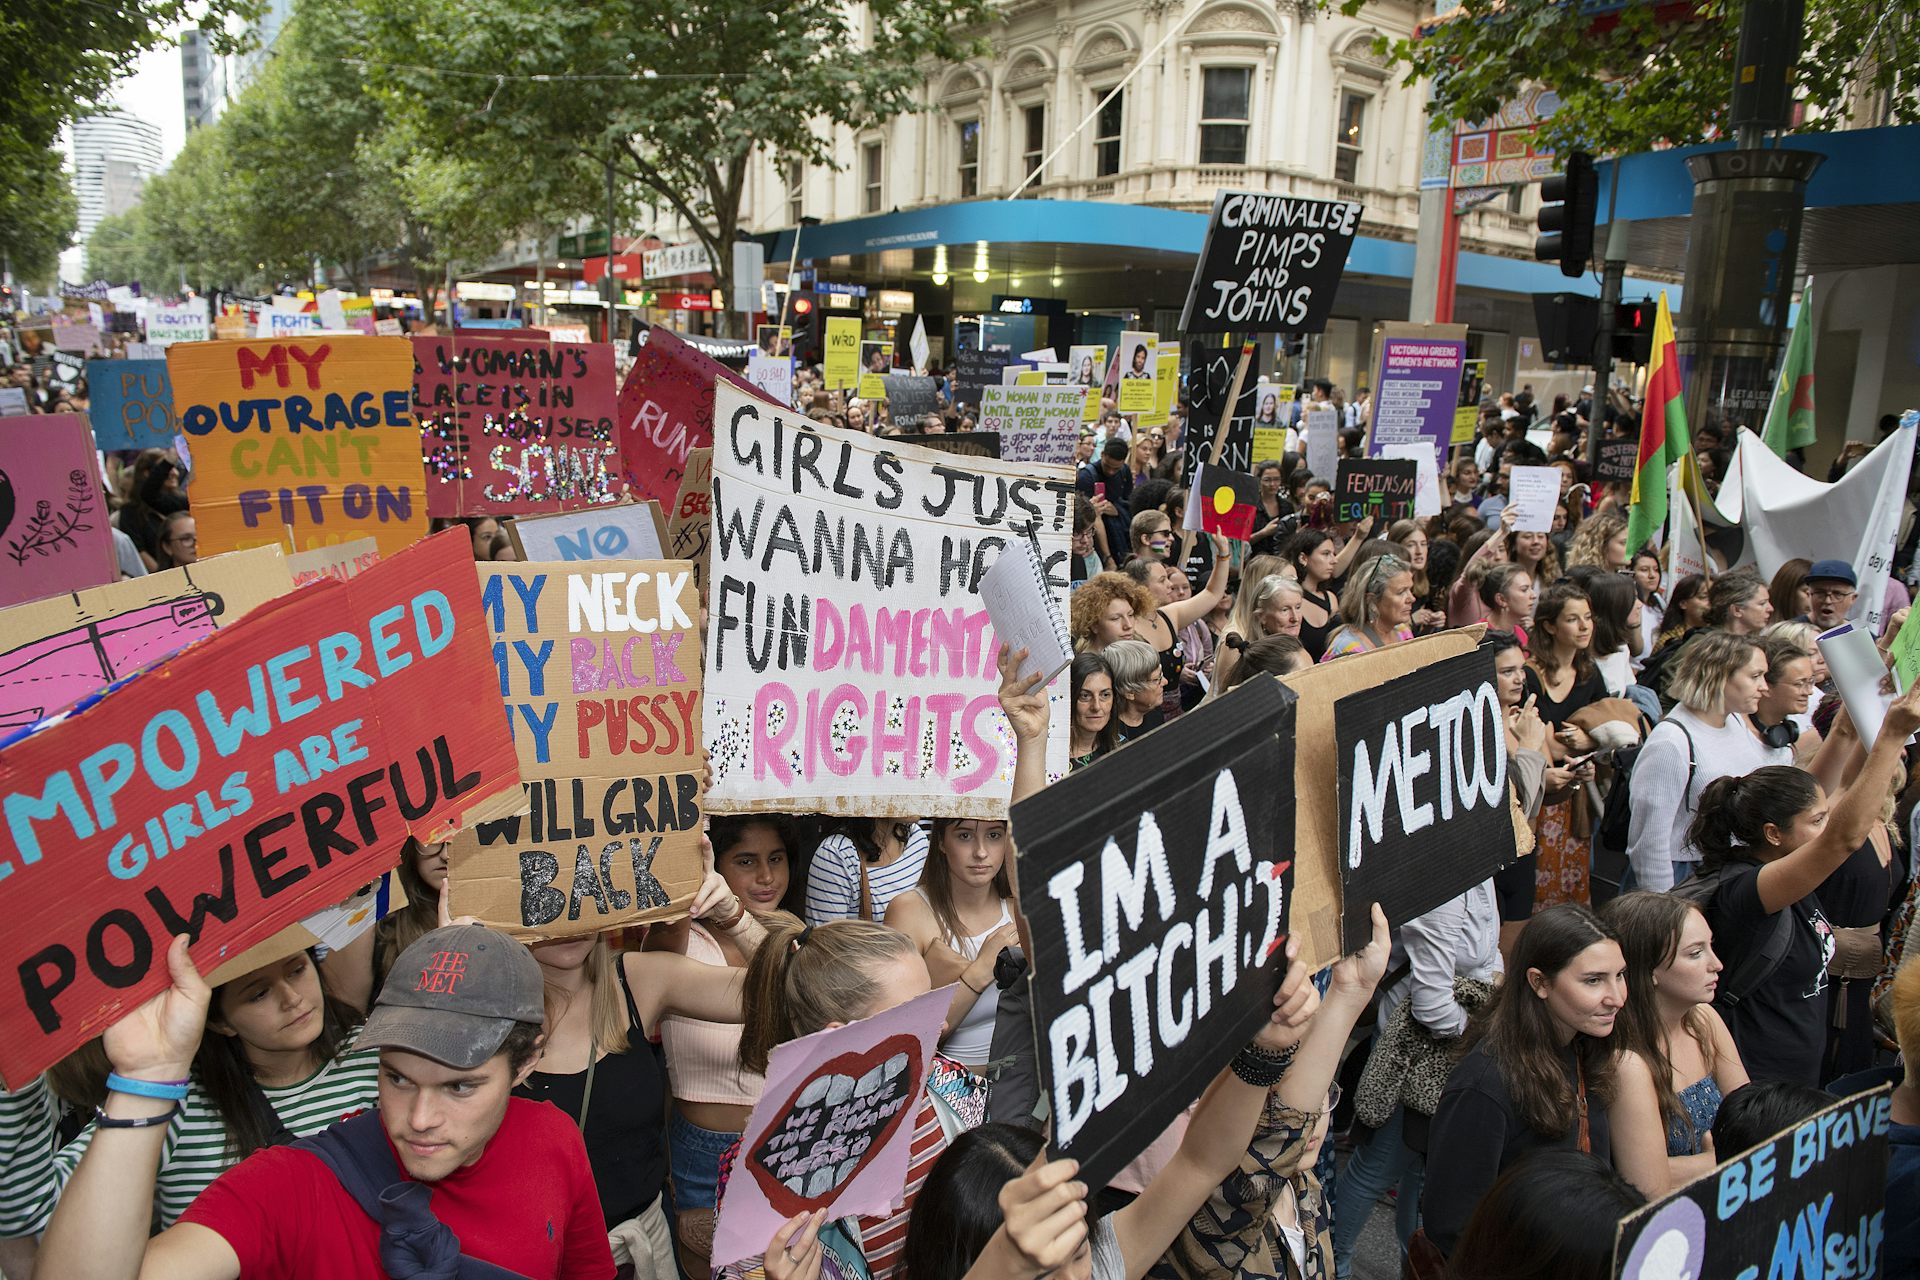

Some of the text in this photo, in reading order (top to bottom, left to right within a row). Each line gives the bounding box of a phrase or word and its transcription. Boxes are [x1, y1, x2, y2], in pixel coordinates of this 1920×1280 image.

[1221, 194, 1361, 236] CRIMINALISE
[1235, 230, 1326, 269] PIMPS
[1245, 267, 1289, 289] AND
[156, 314, 203, 325] EQUITY
[271, 314, 311, 329] FIGHT
[1205, 280, 1312, 325] JOHNS
[236, 343, 333, 391] MY
[436, 345, 588, 380] WOMAN'S
[1388, 356, 1458, 368] WOMEN'S NETWORK
[1390, 344, 1457, 357] VICTORIAN GREENS
[182, 390, 412, 436] OUTRAGE
[538, 382, 574, 409] IN
[984, 405, 1081, 418] UNTIL EVERY WOMAN
[985, 388, 1081, 405] NO WOMAN IS FREE
[1002, 417, 1047, 430] IS FREE
[1011, 432, 1037, 446] group
[1040, 427, 1053, 442] of
[1052, 433, 1080, 442] women
[229, 434, 381, 478] CAN'T
[1014, 440, 1032, 454] for
[1057, 442, 1074, 453] this
[730, 403, 904, 511] GIRLS
[920, 461, 1076, 538] JUST
[238, 484, 412, 528] FIT ON
[1339, 499, 1415, 523] EQUALITY
[712, 475, 915, 592] WANNA
[1867, 552, 1886, 573] day
[567, 571, 694, 634] NECK
[570, 632, 690, 694] BACK
[0, 588, 456, 884] MPOWERED
[576, 690, 699, 760] PUSSY
[753, 680, 1002, 795] RIGHTS
[107, 717, 370, 881] GIRLS ARE
[602, 773, 700, 837] GRAB
[17, 735, 482, 1035] POWERFUL
[519, 836, 672, 928] BACK
[1048, 767, 1254, 996] IM A
[414, 970, 465, 995] MET
[426, 951, 469, 973] THE
[767, 1094, 910, 1150] THE RIGHT
[785, 1082, 898, 1130] WE HAVE
[762, 1145, 800, 1167] TO
[776, 1133, 872, 1179] HEARD
[1717, 1142, 1777, 1222] BE
